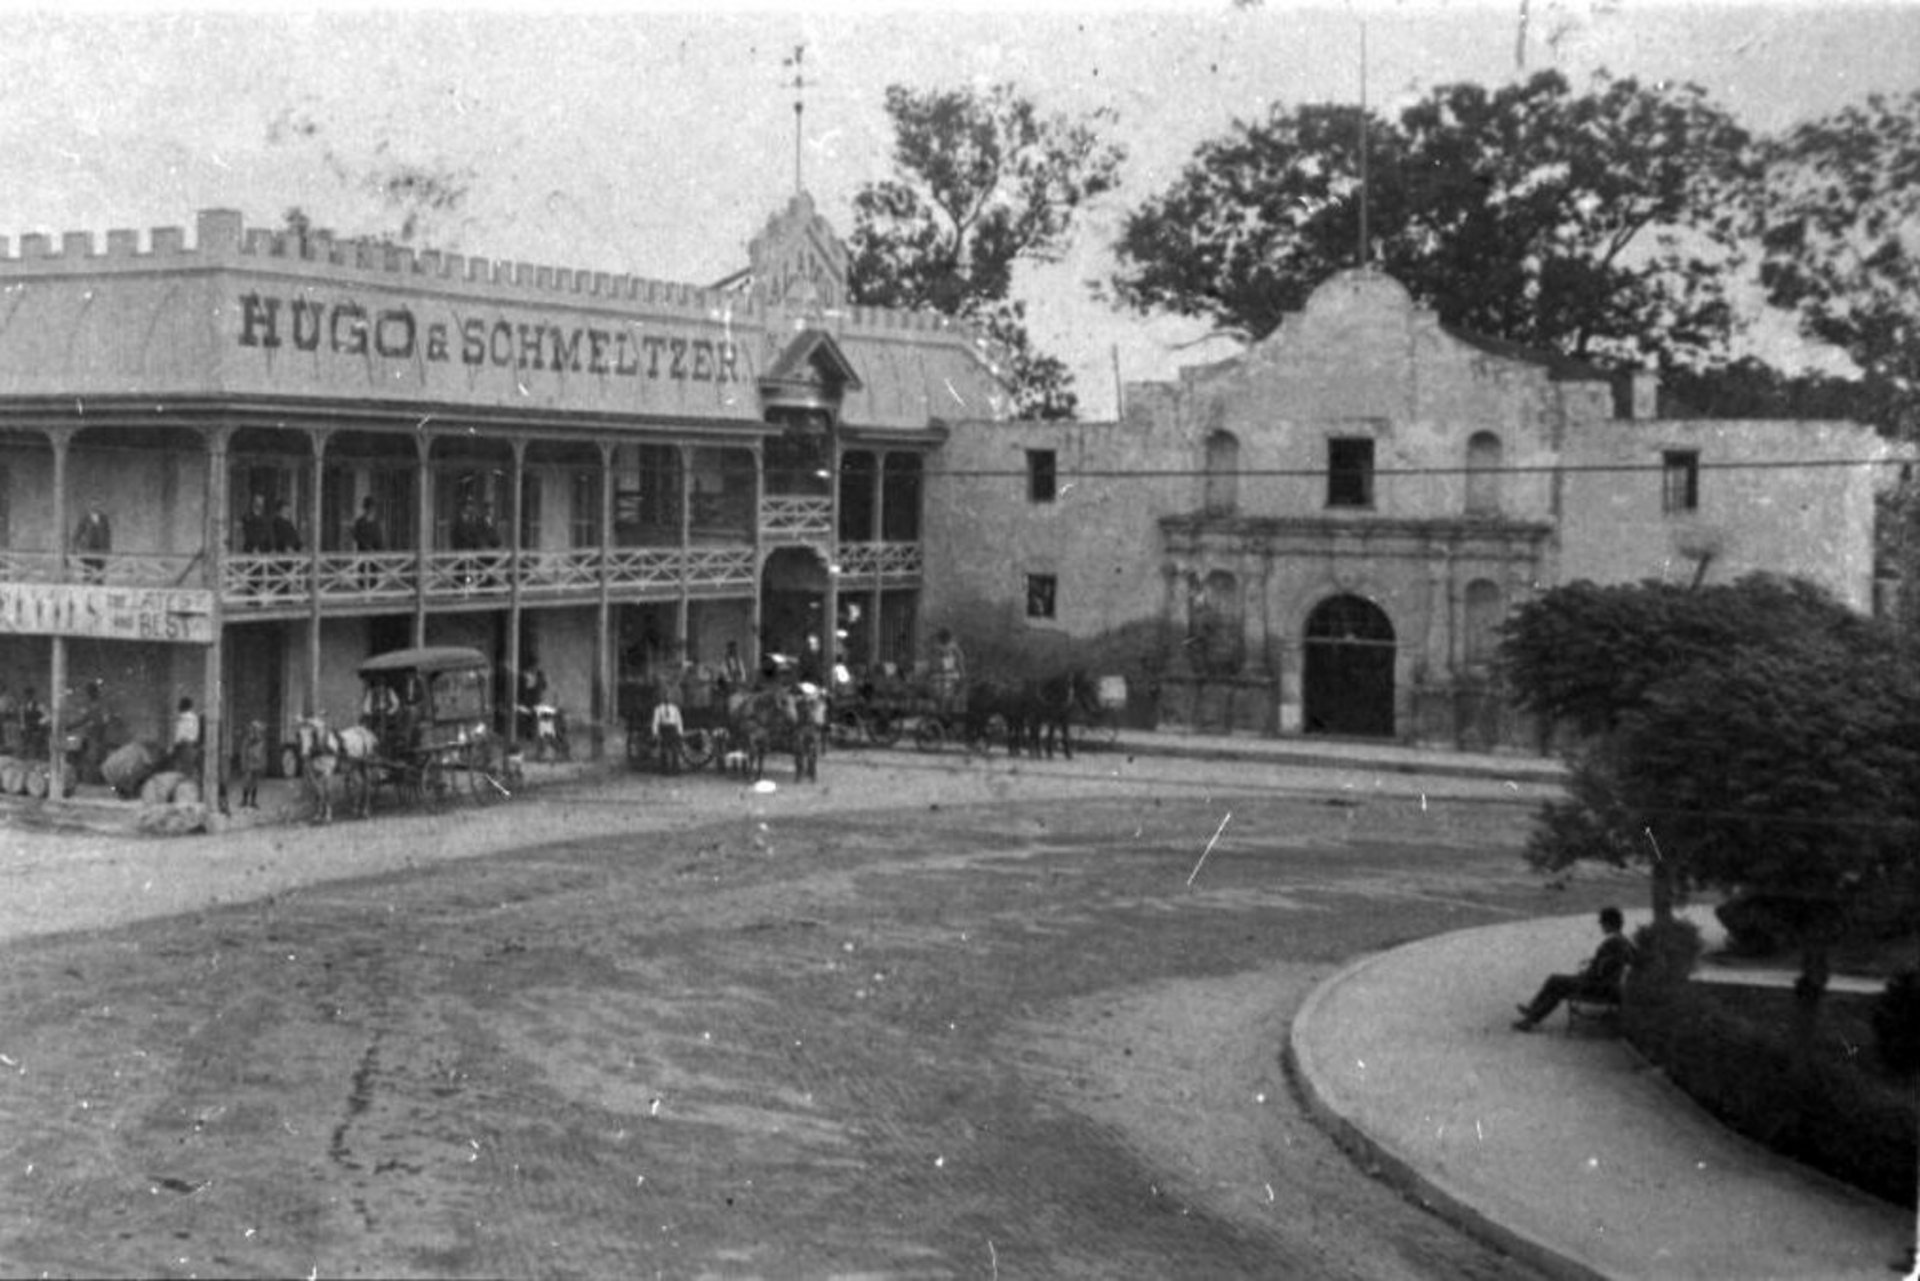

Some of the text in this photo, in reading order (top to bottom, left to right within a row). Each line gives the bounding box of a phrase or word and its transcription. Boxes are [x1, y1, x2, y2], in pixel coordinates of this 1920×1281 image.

[238, 293, 739, 383] HUGO & SCHMELTZER
